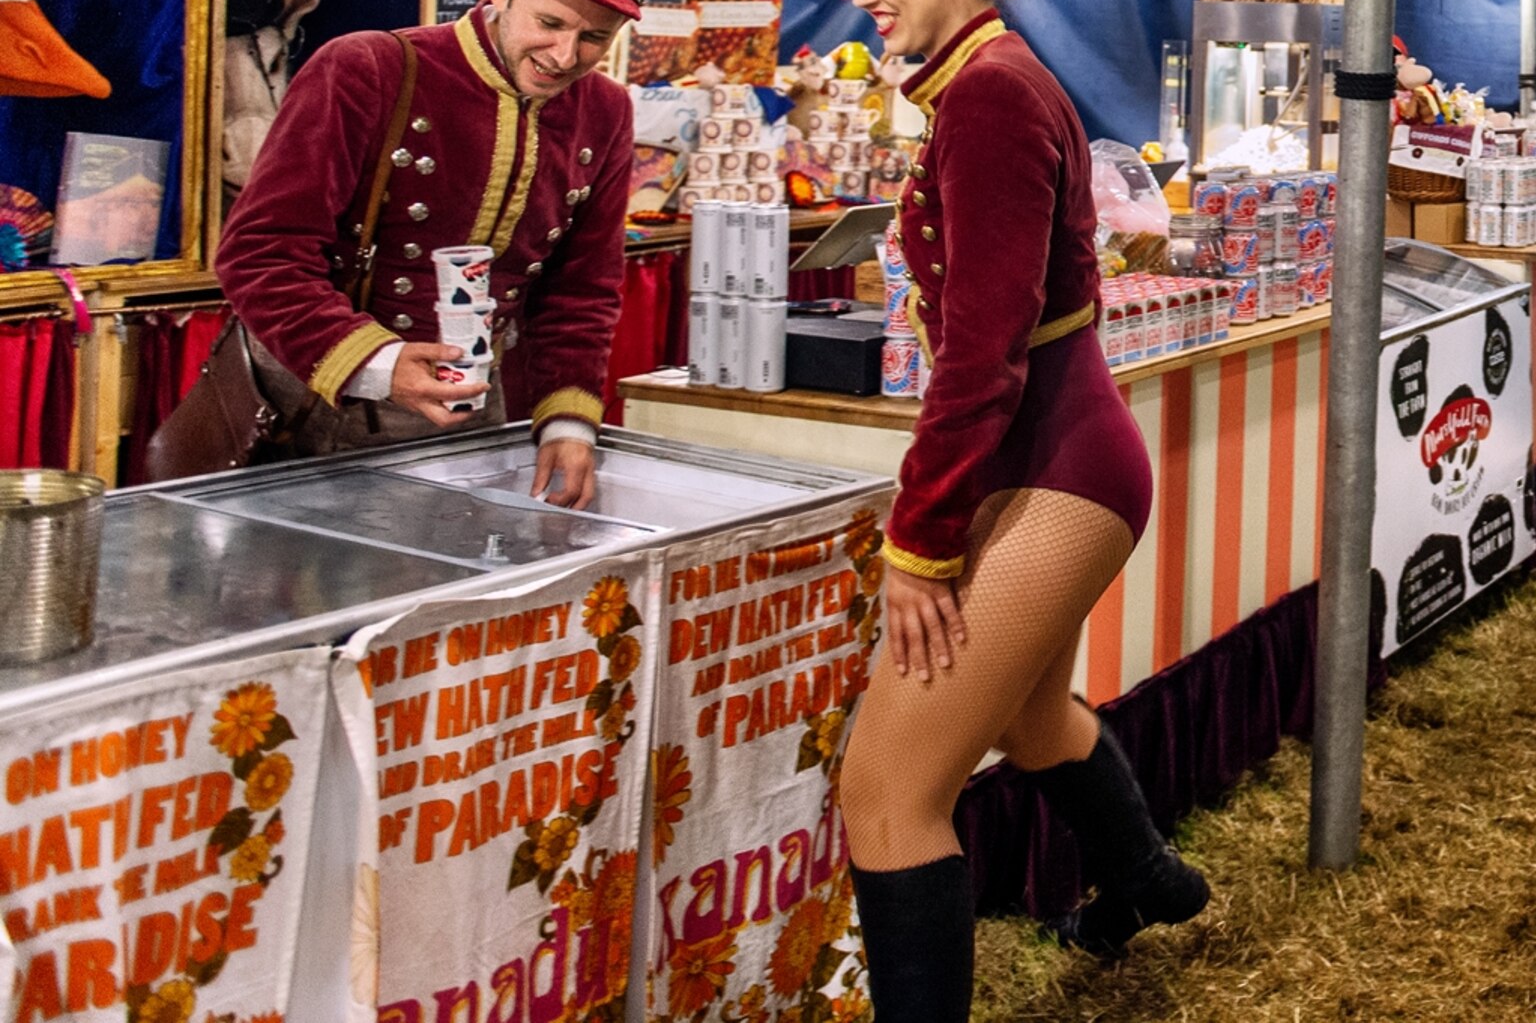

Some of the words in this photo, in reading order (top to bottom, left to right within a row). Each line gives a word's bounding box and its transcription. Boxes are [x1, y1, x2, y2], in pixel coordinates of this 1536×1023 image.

[668, 605, 736, 666] DEW
[738, 584, 804, 647] HATH
[807, 568, 858, 623] FED
[715, 555, 741, 594] HE
[403, 631, 440, 680] HE
[446, 622, 484, 667] ON
[485, 600, 574, 658] HONEY
[374, 691, 430, 757] EW
[435, 664, 528, 741] HATH
[529, 648, 599, 711] FED
[722, 644, 873, 749] PARADISE
[6, 747, 62, 805] ON
[70, 711, 194, 787] HONEY
[378, 760, 419, 800] ND
[421, 736, 498, 788] DRANK
[502, 722, 538, 761] THE
[541, 710, 598, 749] MILK
[137, 771, 234, 849] FED
[413, 740, 621, 865] PARADISE
[4, 884, 103, 944] RANK
[14, 882, 264, 1023] ARDISE
